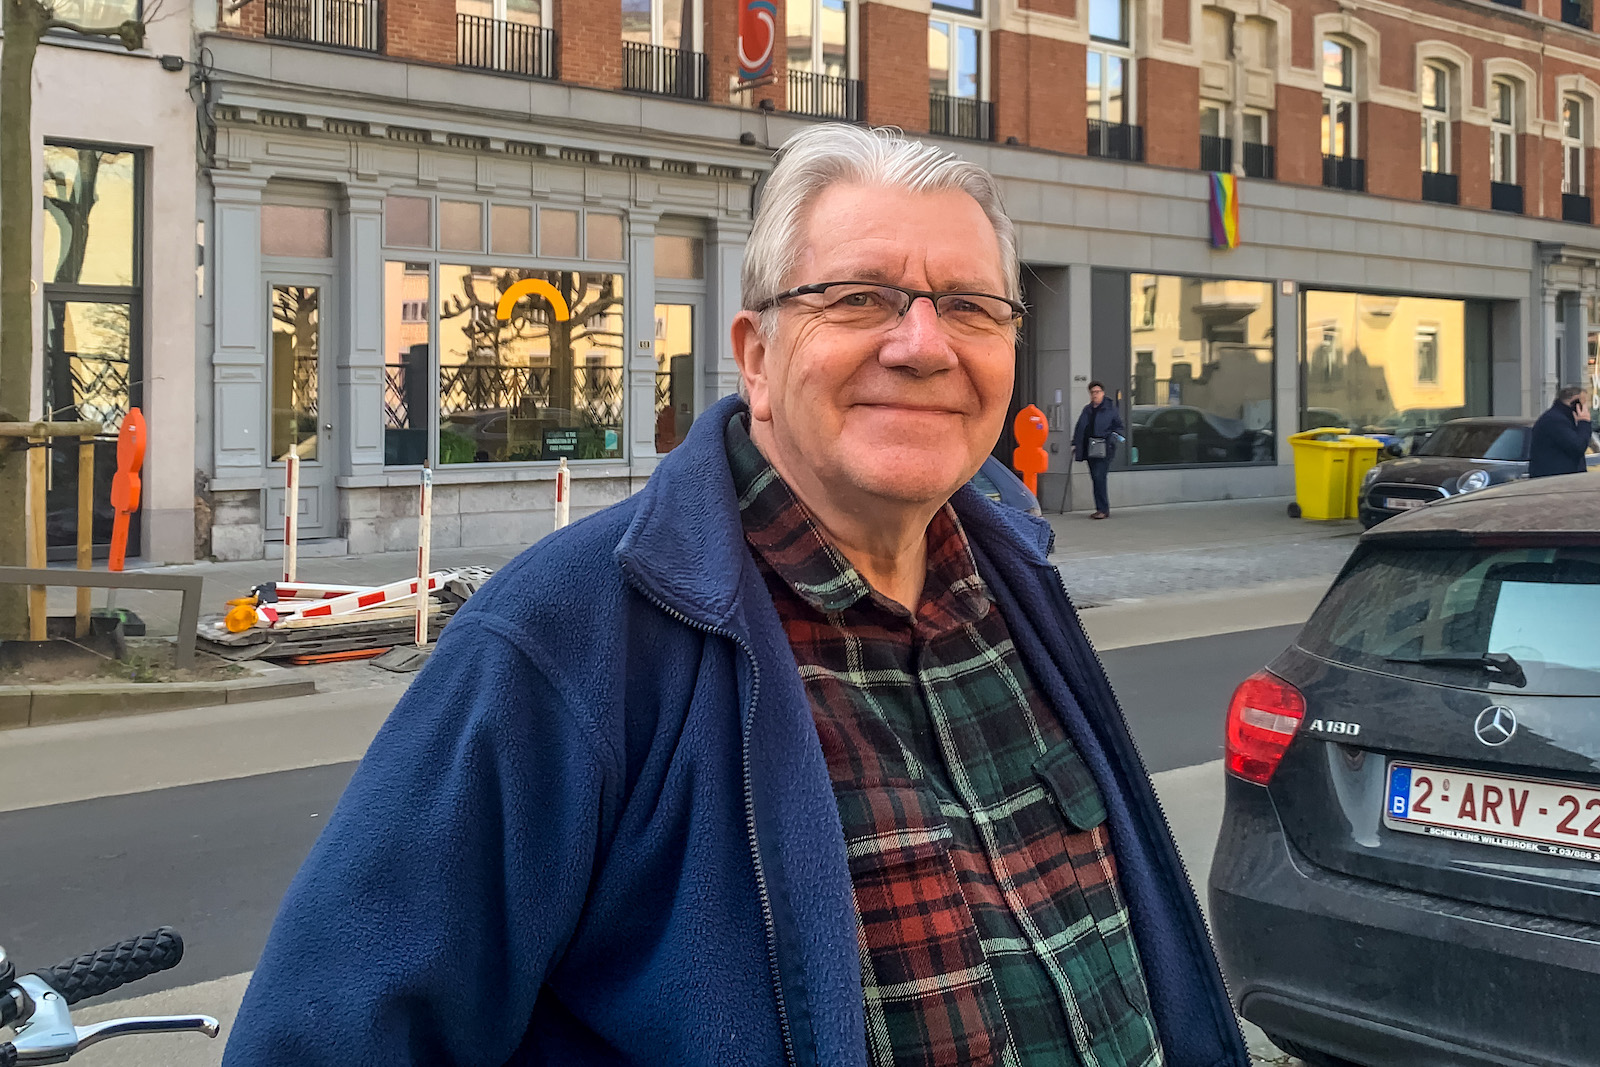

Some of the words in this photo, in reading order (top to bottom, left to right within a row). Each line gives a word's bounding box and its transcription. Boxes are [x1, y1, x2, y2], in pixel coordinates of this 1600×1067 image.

[1309, 719, 1323, 732] A
[1326, 720, 1361, 736] 180
[1393, 797, 1405, 813] B
[1430, 827, 1480, 841] SCHELKENS
[1481, 835, 1540, 851] WILLEBROEK
[1559, 847, 1592, 860] 03/886
